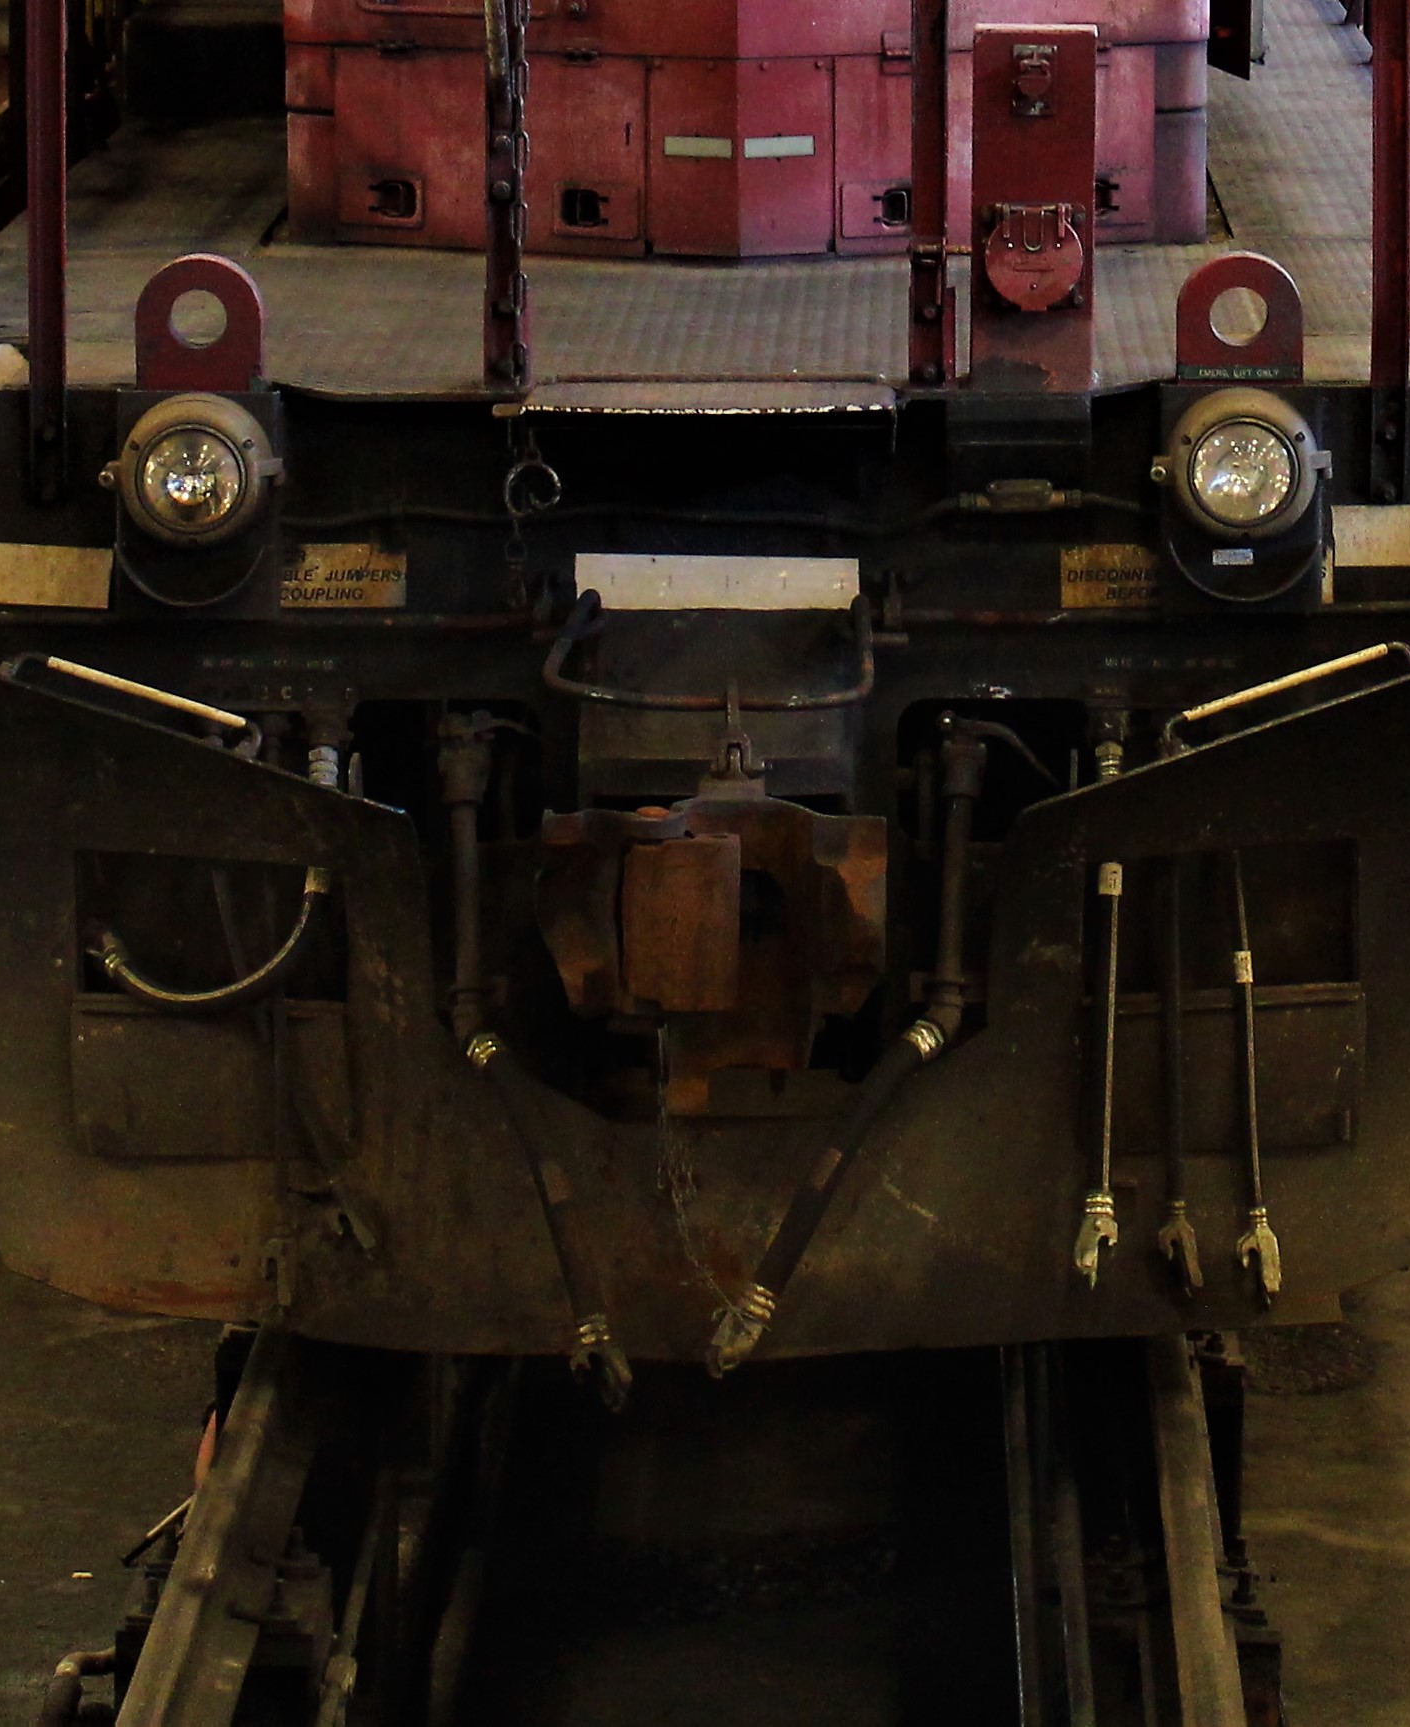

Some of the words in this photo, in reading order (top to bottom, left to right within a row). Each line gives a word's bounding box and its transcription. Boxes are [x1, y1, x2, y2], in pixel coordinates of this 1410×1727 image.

[284, 569, 314, 582] BLE
[1067, 569, 1156, 583] DISCONNE
[281, 587, 364, 600] COUPLING
